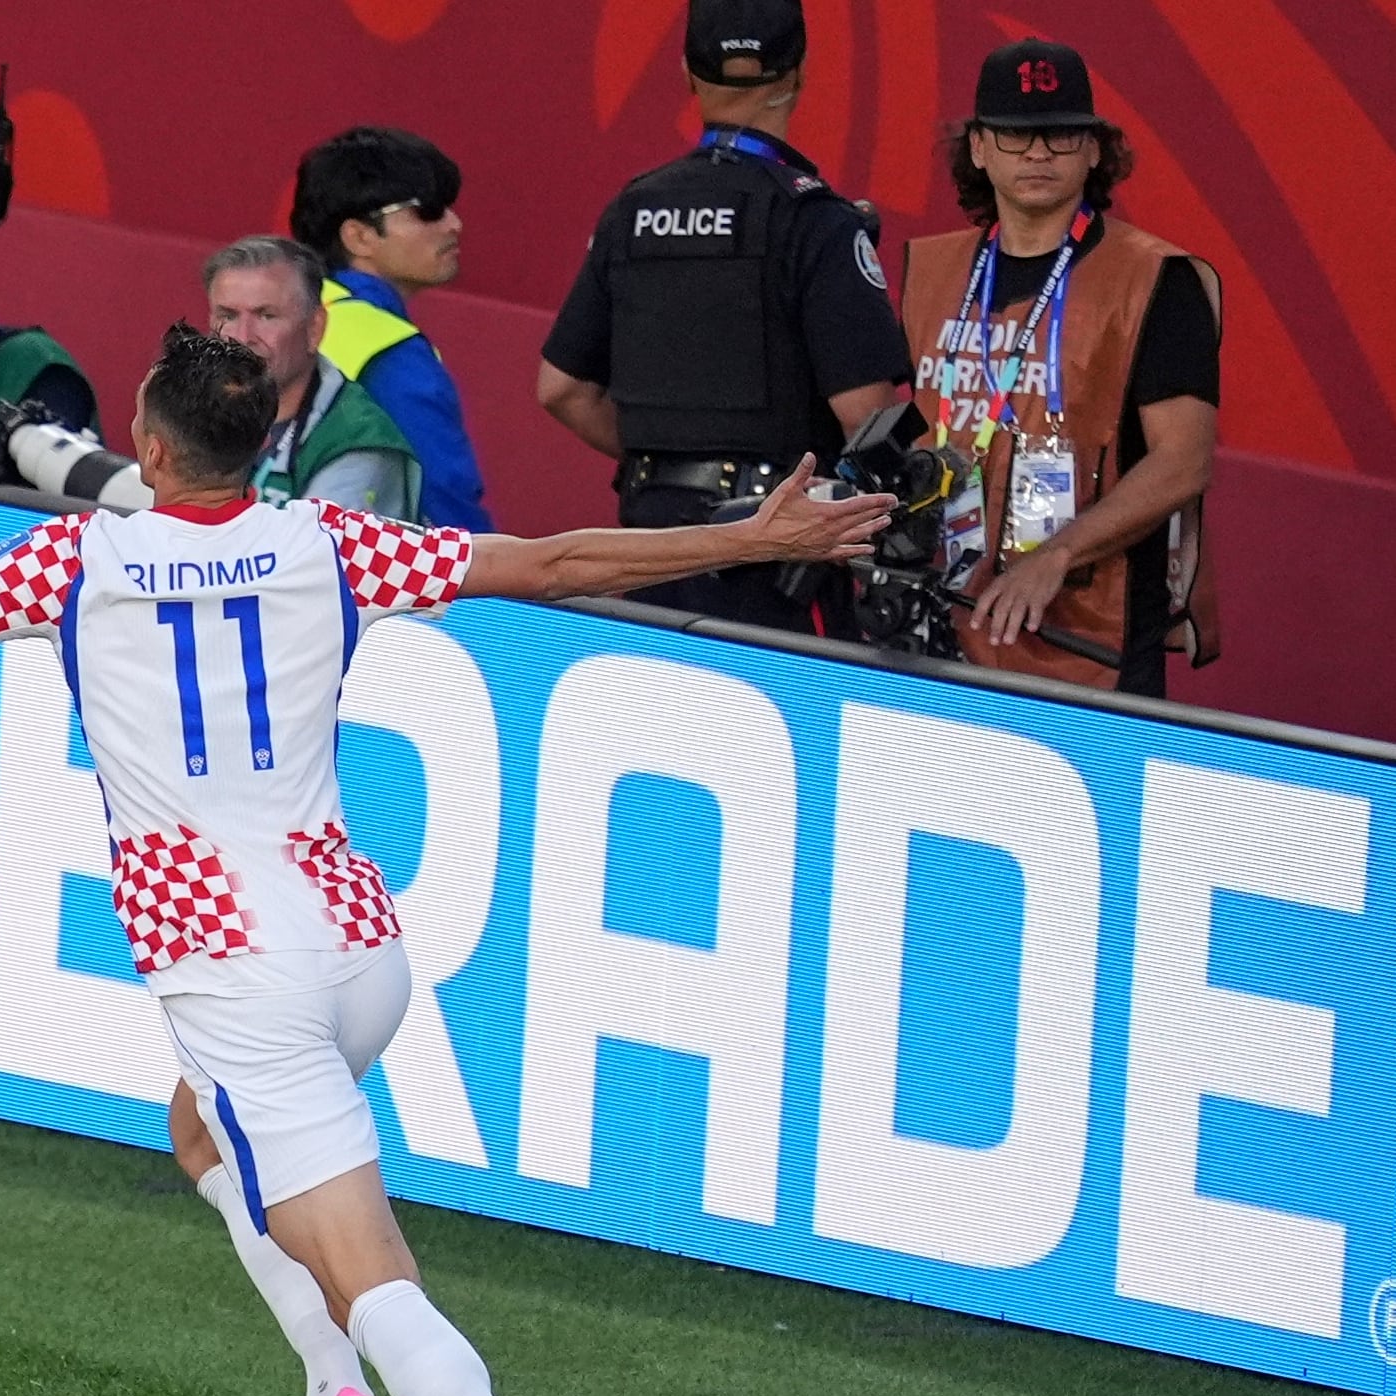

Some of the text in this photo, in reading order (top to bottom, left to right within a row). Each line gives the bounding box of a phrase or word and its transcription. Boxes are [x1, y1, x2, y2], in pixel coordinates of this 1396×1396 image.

[720, 38, 762, 52] POLICE
[634, 208, 735, 237] POLICE
[1027, 295, 1048, 330] WORLD
[1042, 276, 1058, 297] CUP
[938, 398, 994, 433] 79
[157, 595, 275, 777] 11
